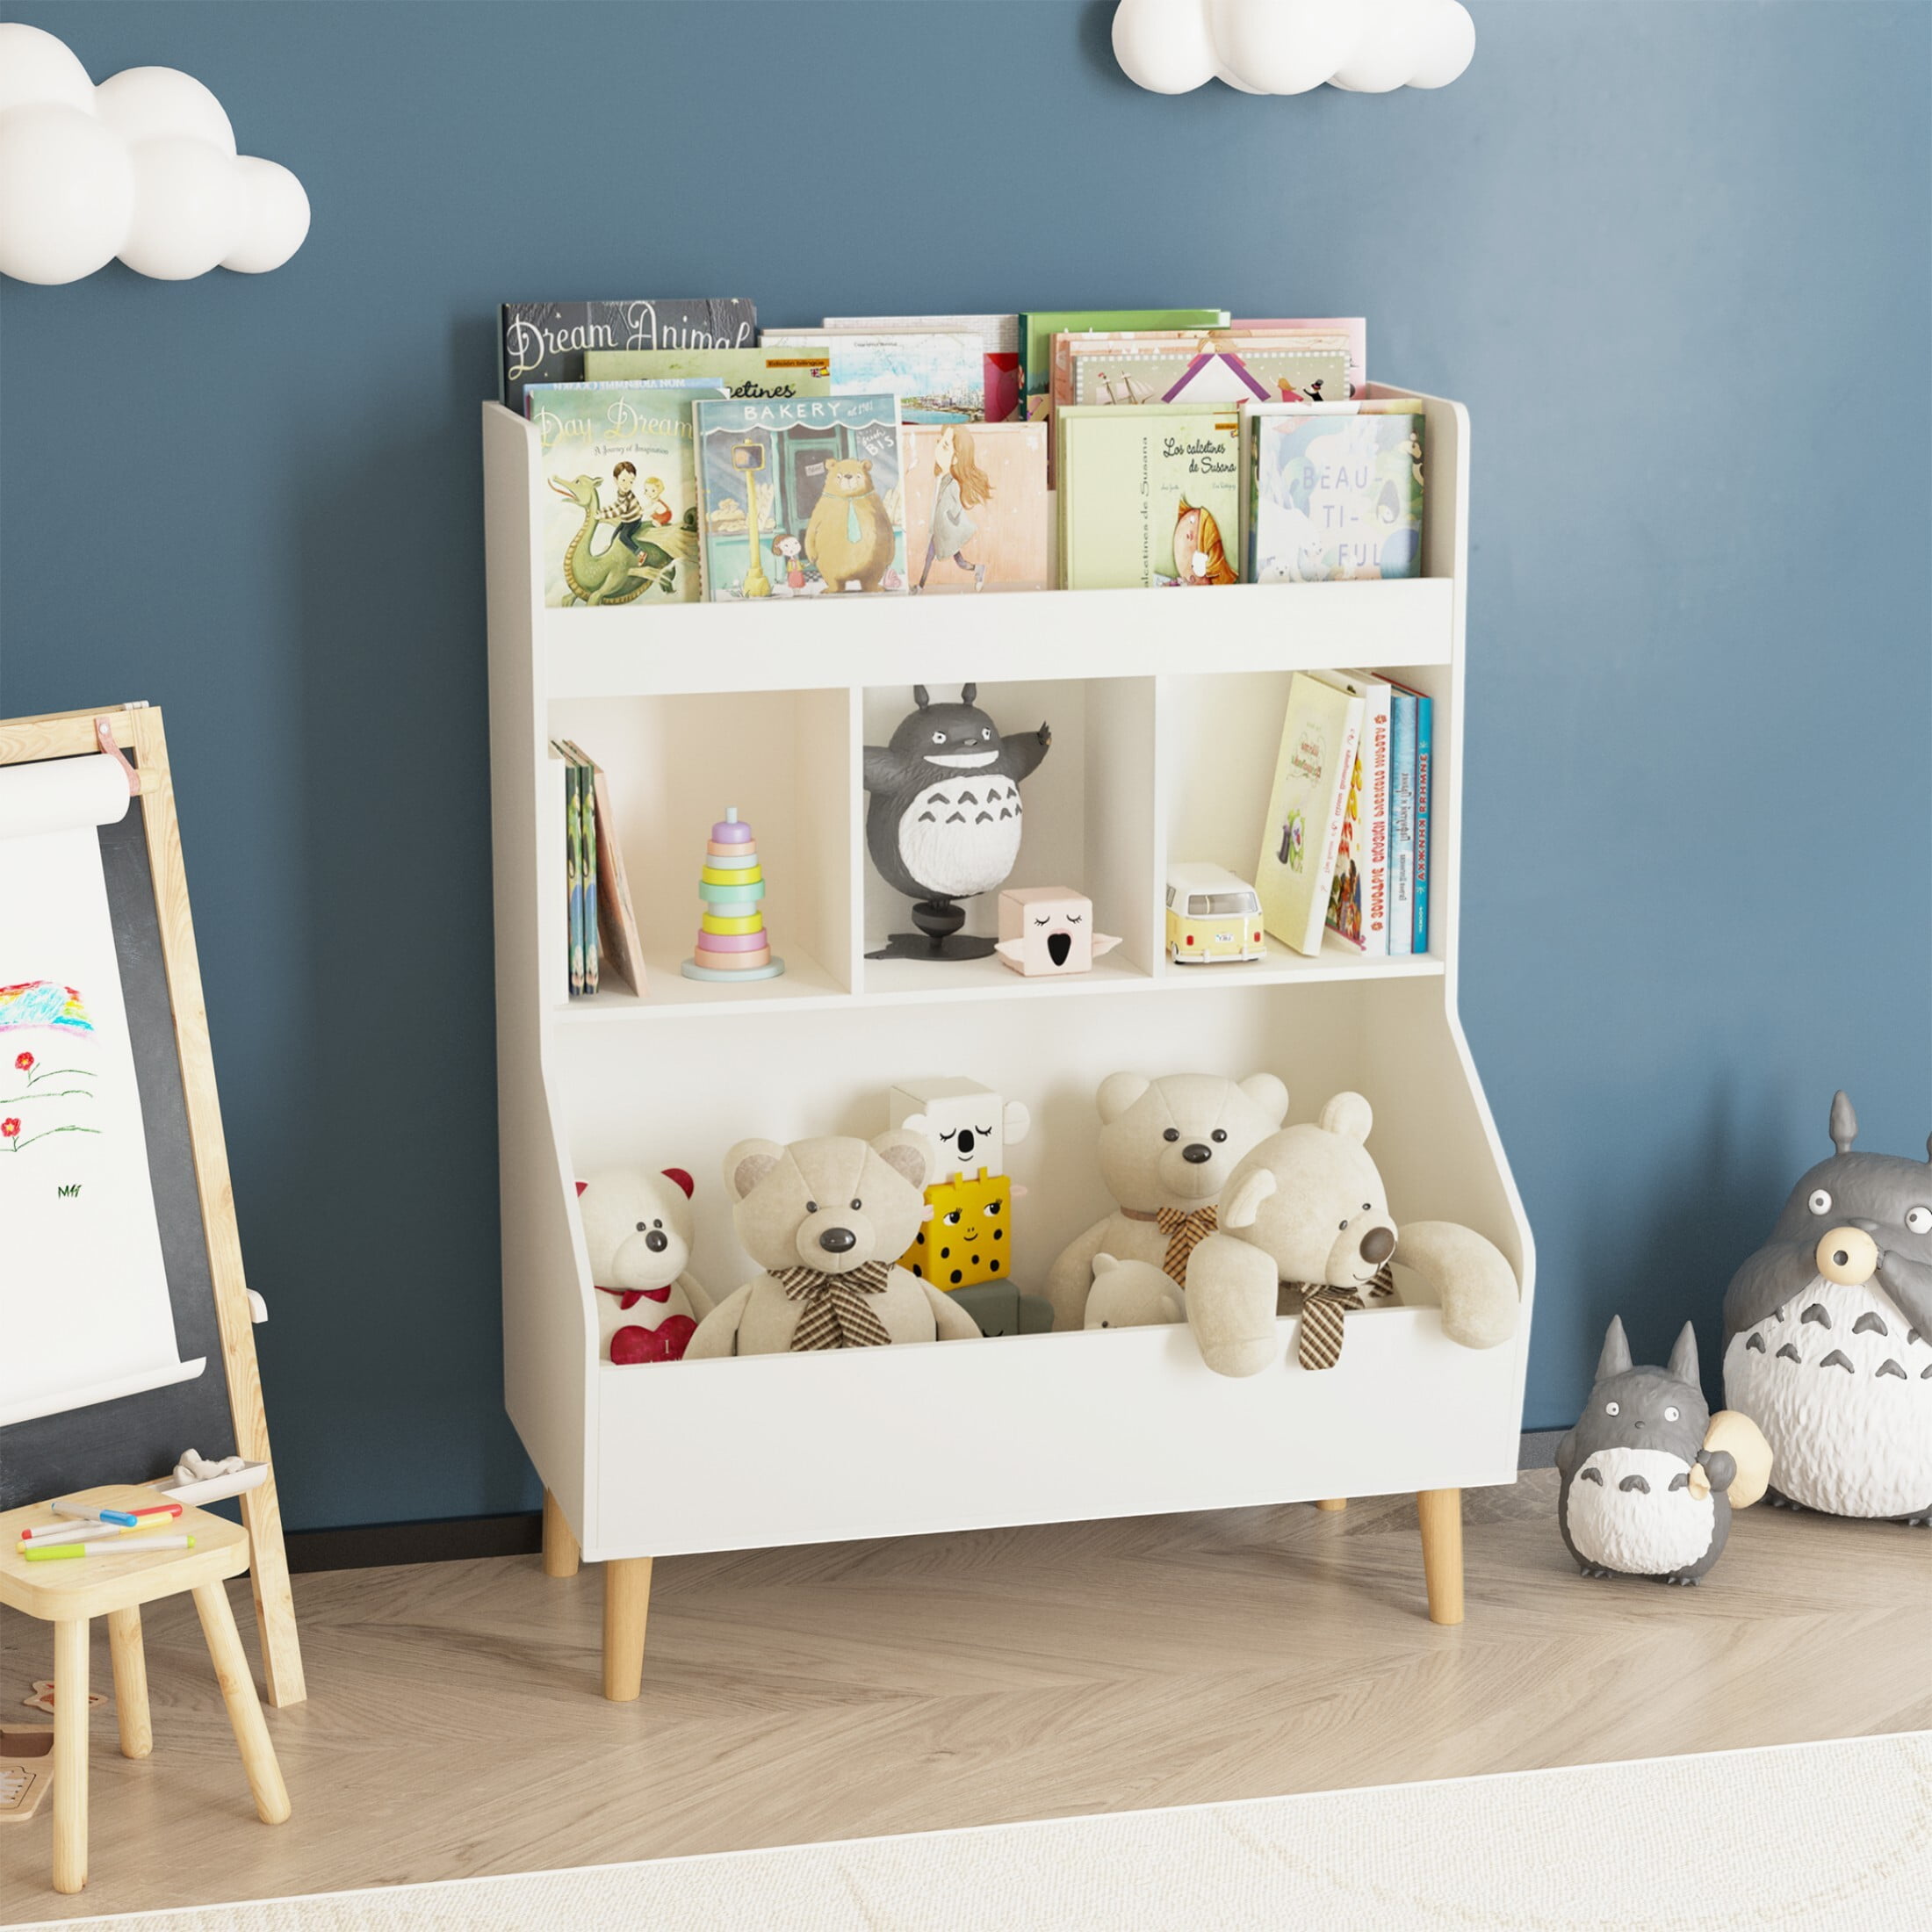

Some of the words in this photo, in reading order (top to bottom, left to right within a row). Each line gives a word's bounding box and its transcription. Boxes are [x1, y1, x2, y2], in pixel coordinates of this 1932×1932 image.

[507, 313, 618, 381] Dream
[534, 406, 593, 448] Day
[604, 395, 693, 440] Dream
[744, 401, 841, 421] BAKERY
[865, 435, 895, 456] BIS
[1163, 437, 1185, 458] Los
[1186, 439, 1226, 455] calcetines
[1140, 436, 1149, 497] Susana
[1188, 458, 1200, 473] de
[1200, 456, 1236, 474] Susana
[1302, 465, 1382, 491] BEAU-
[1140, 501, 1148, 521] de
[1323, 505, 1359, 528] TI-
[1338, 543, 1381, 566] FUL
